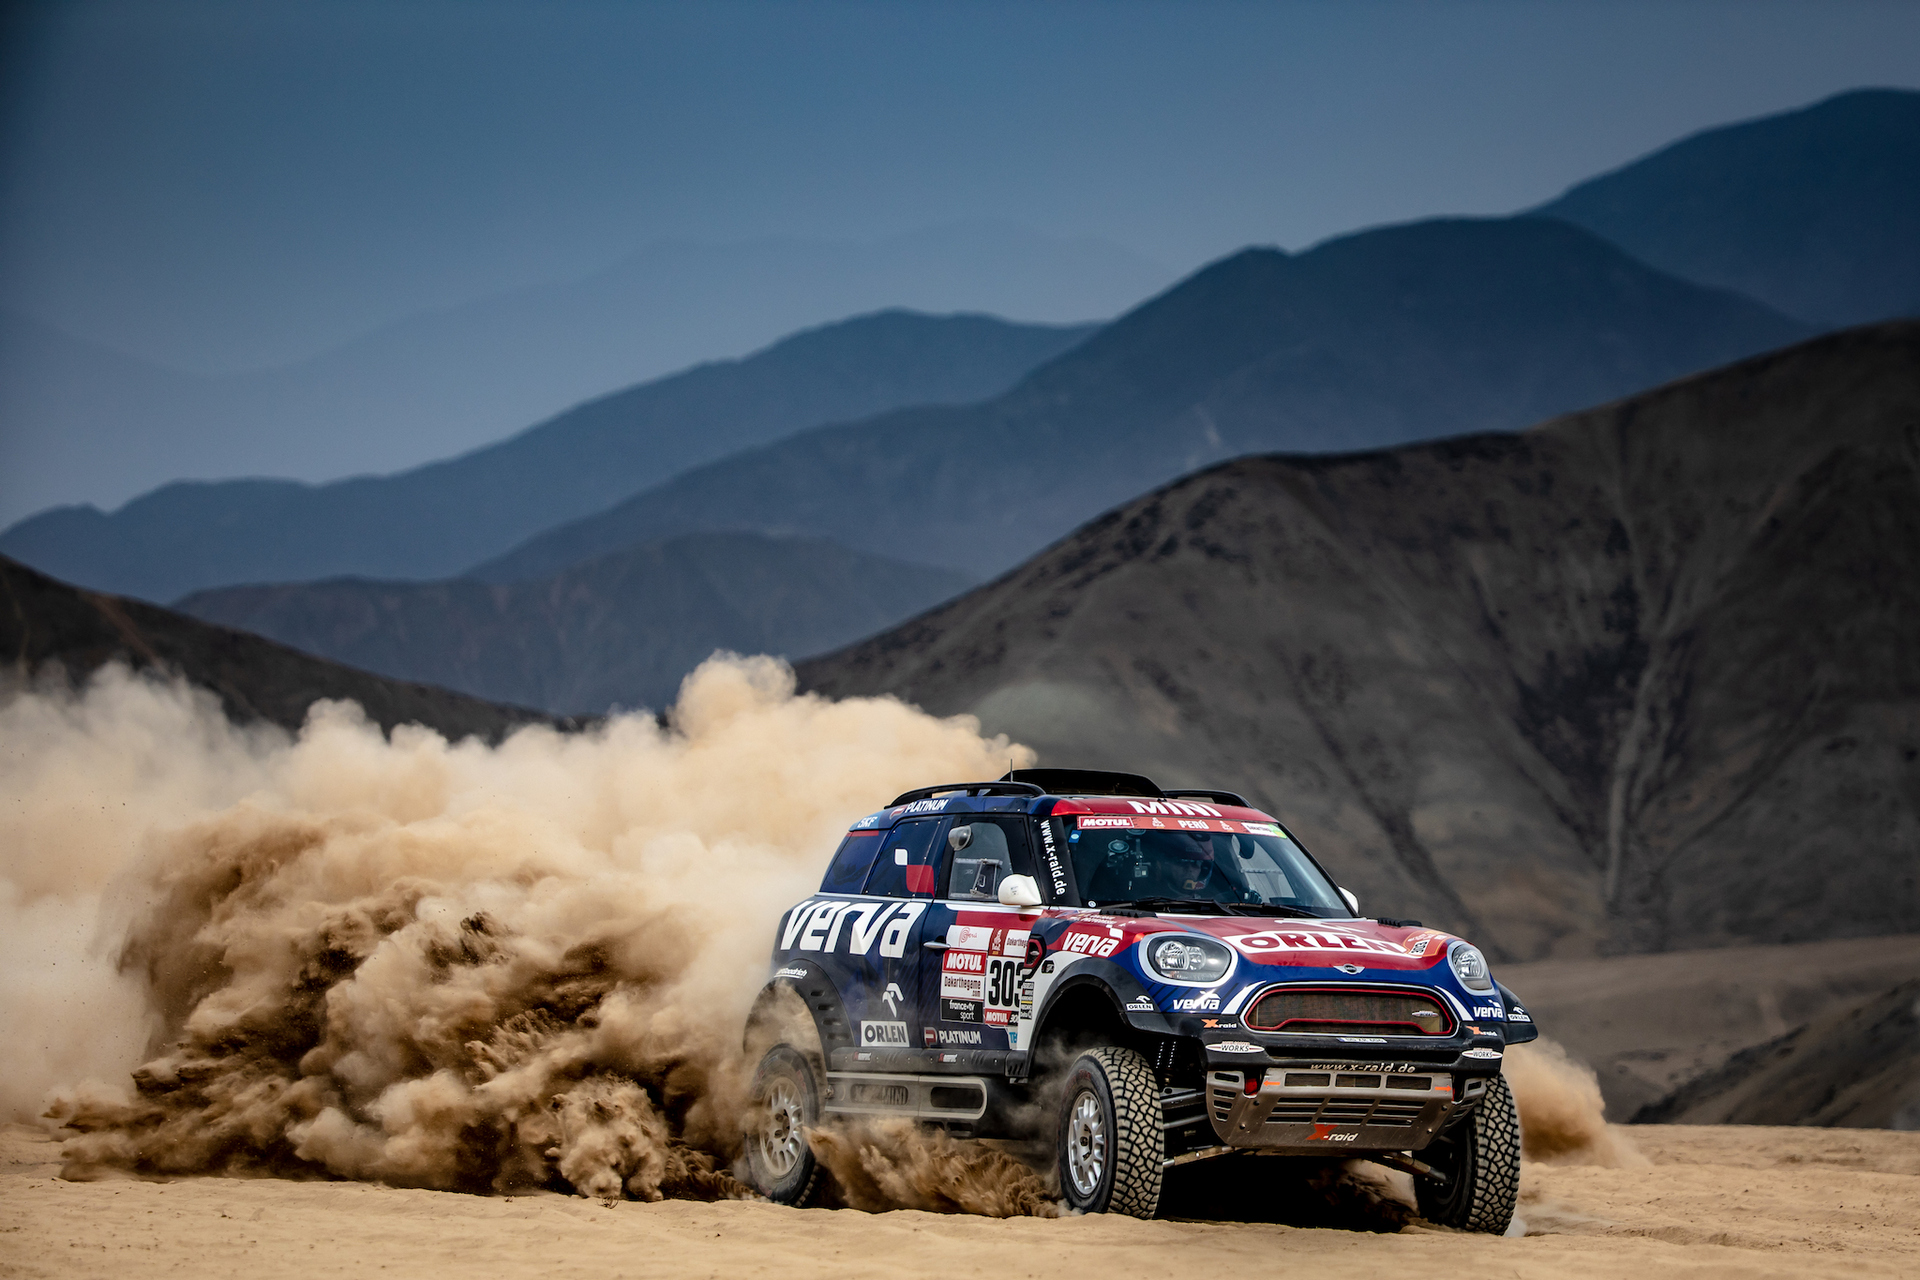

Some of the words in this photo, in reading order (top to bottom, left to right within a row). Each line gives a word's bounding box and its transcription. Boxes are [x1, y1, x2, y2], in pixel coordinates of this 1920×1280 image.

[905, 799, 949, 813] PLATINUM
[1127, 801, 1222, 817] MINI
[857, 816, 878, 828] SKF
[1082, 818, 1131, 827] MOTUL
[1040, 819, 1067, 896] www.x-raid.de
[1240, 931, 1407, 953] ORLEN
[946, 953, 982, 971] MOTUL
[960, 1010, 974, 1022] sport
[986, 1011, 1009, 1023] MOTUL
[864, 1024, 907, 1043] ORLEN
[939, 1030, 982, 1044] PLATINUM
[1221, 1044, 1250, 1052] WORKS
[1310, 1063, 1416, 1073] www.x-raid.de
